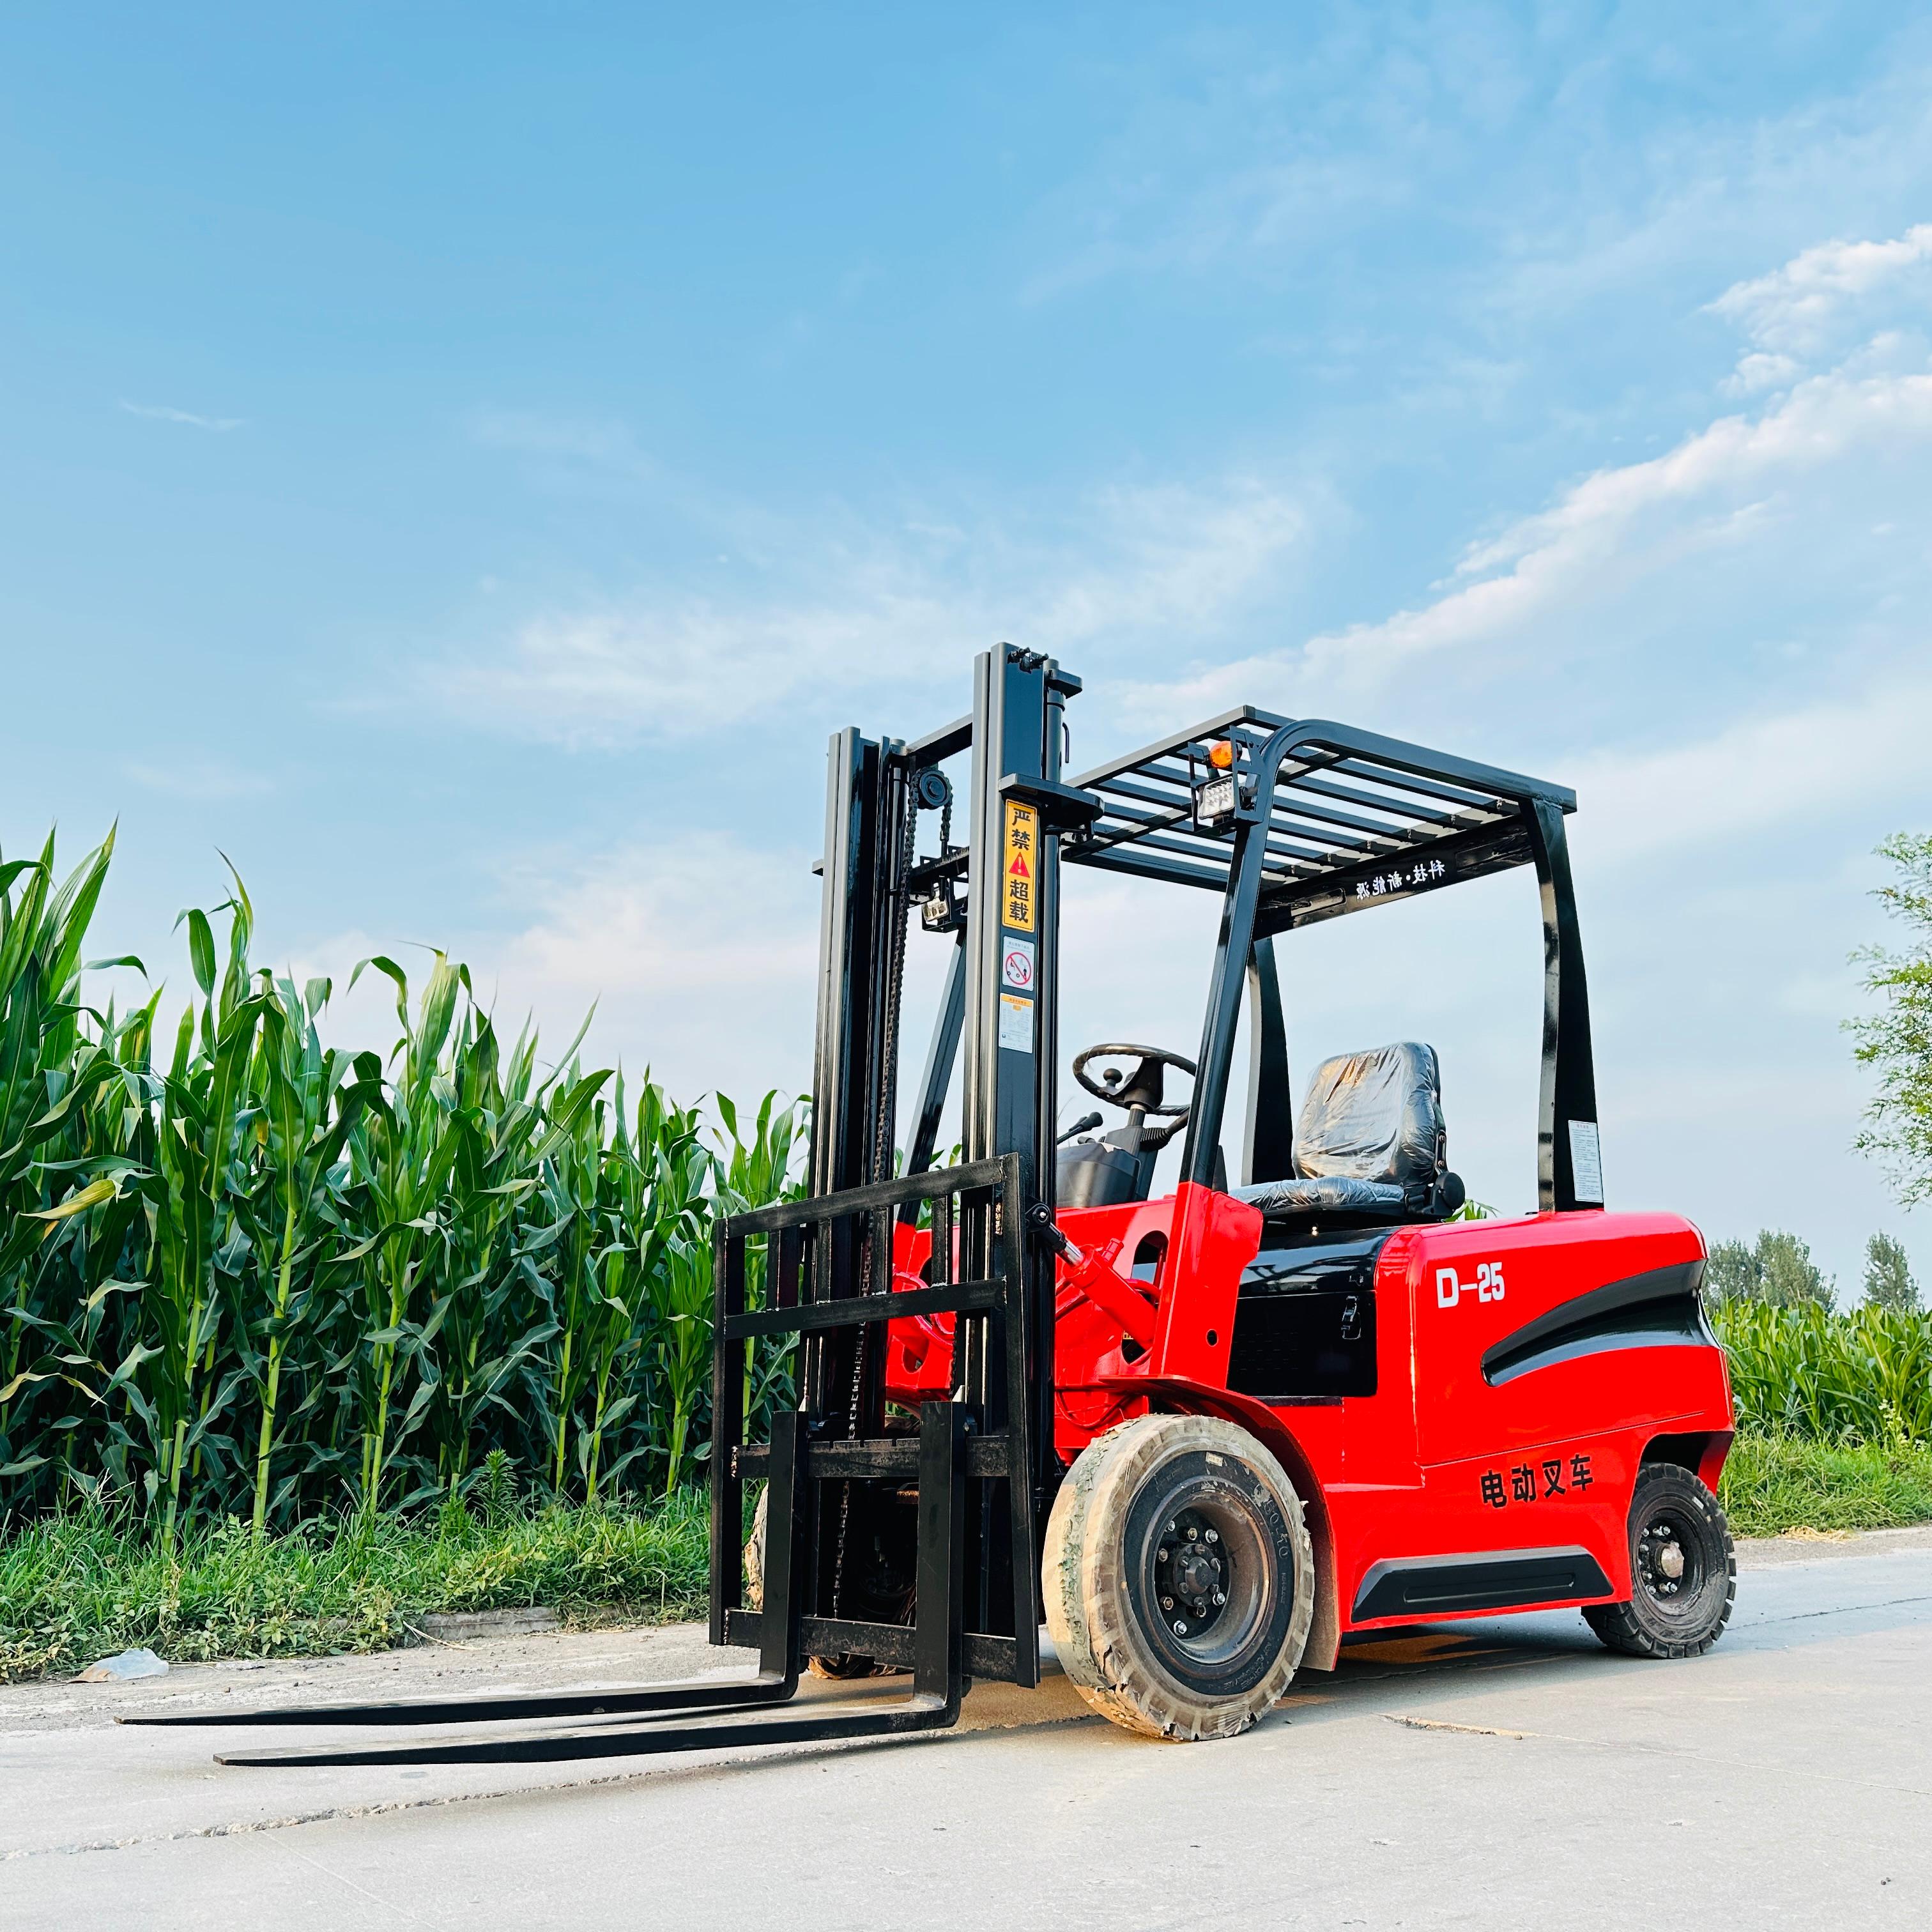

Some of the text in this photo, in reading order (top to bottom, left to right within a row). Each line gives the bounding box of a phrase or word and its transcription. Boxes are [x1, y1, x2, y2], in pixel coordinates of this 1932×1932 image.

[1436, 1262, 1505, 1308] D-25
[1481, 1454, 1593, 1508] 电动叉车
